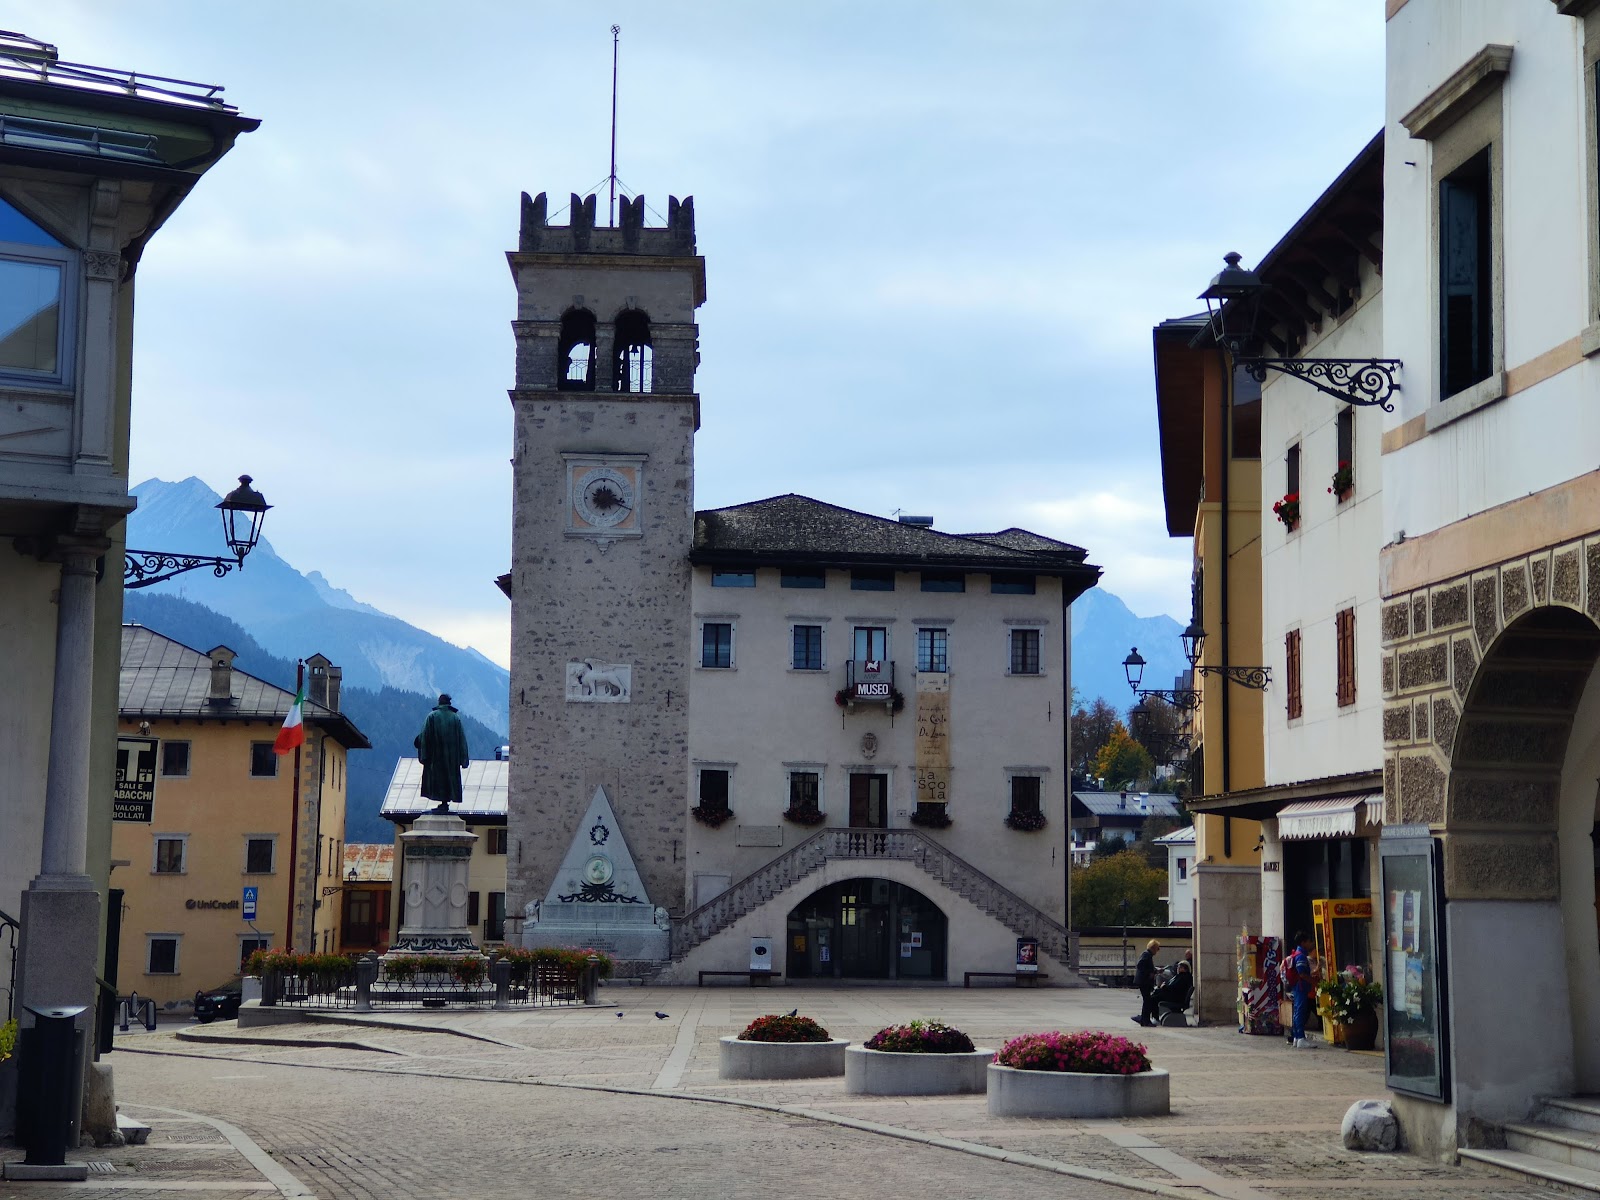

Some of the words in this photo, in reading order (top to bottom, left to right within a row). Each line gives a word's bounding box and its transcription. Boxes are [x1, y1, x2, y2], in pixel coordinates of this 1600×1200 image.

[858, 684, 889, 695] MUSEO
[919, 726, 929, 737] De
[119, 782, 136, 790] SALI
[114, 790, 152, 800] ABACCHI
[115, 804, 143, 812] VALORI
[197, 899, 239, 909] UniCredit
